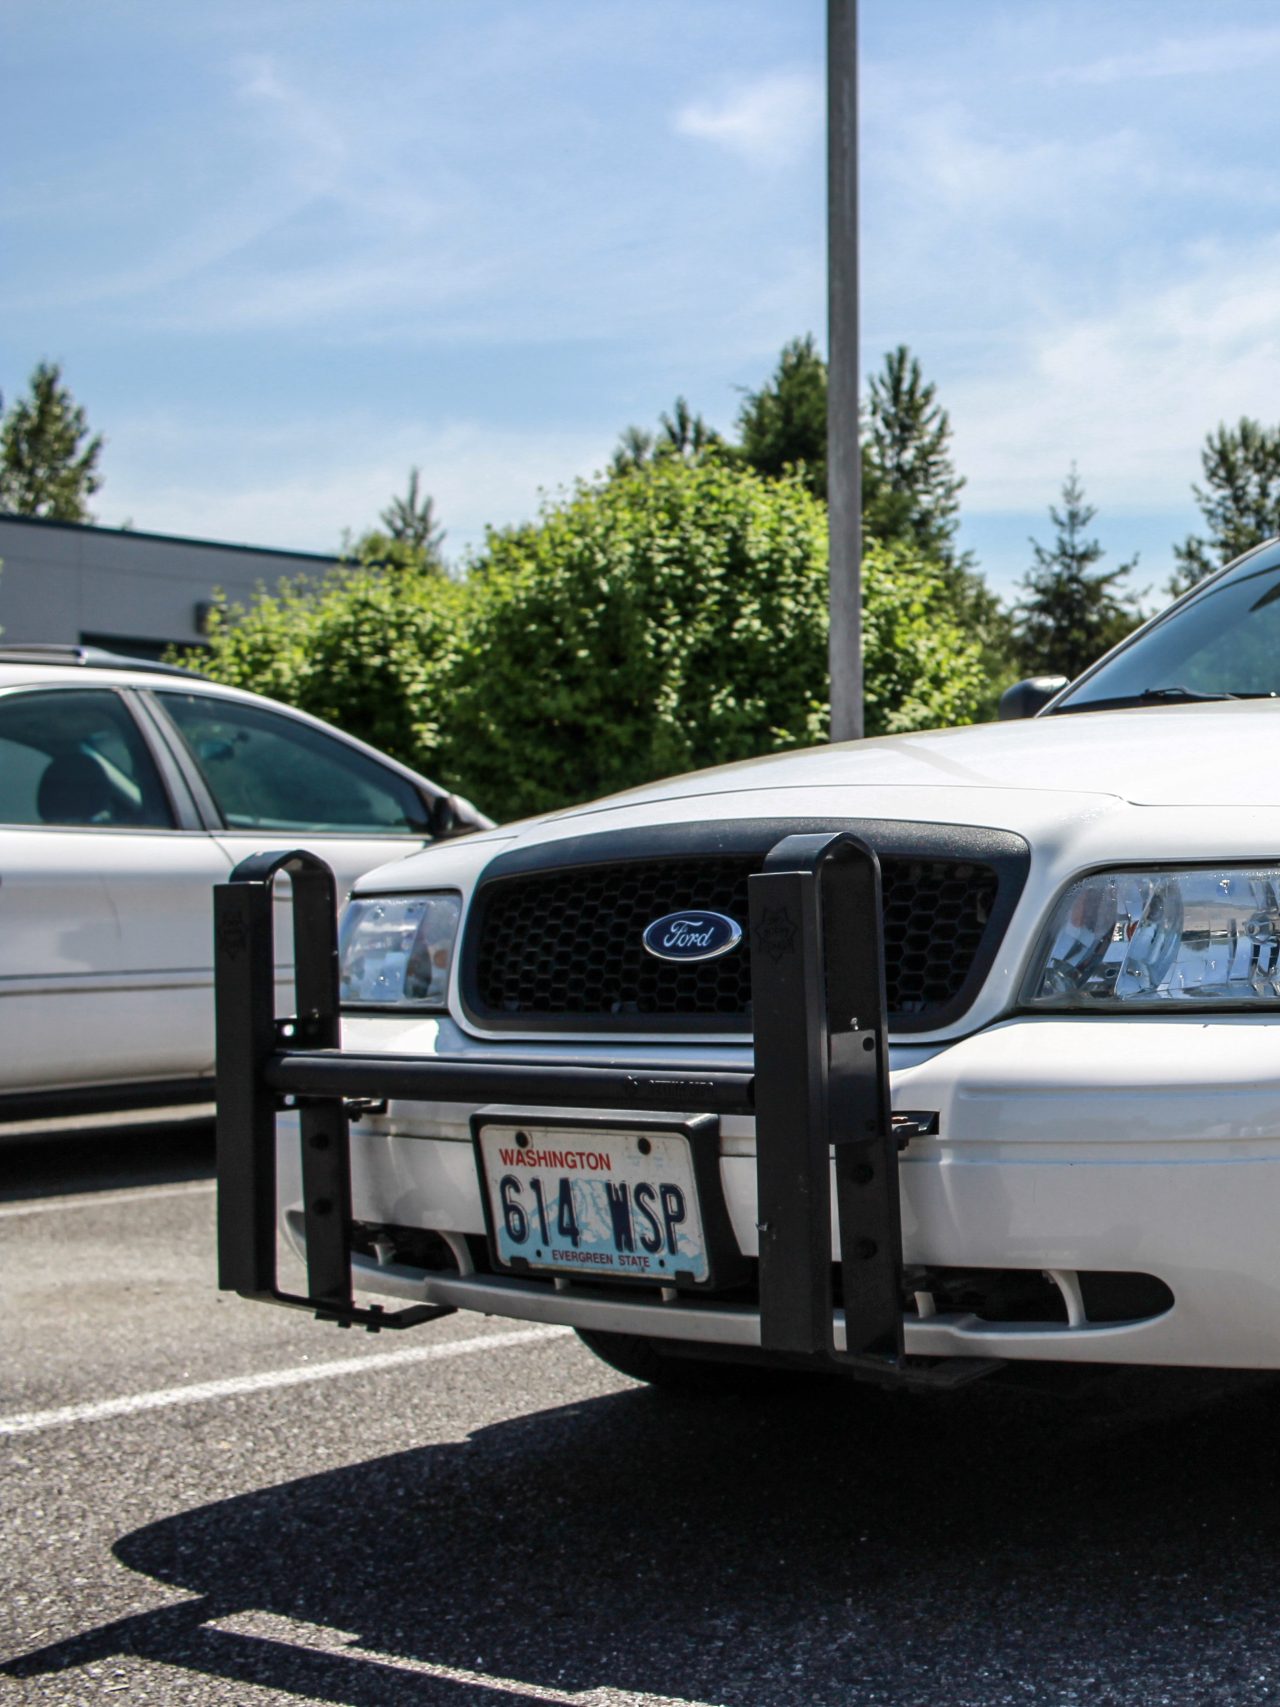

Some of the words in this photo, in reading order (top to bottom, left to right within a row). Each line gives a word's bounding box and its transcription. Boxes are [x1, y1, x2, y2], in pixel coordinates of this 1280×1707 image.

[663, 920, 715, 947] Ford
[499, 1148, 612, 1171] WASHINGTON
[500, 1174, 581, 1248] 614
[606, 1179, 687, 1256] WSP
[552, 1249, 613, 1265] EVERGREEN
[618, 1254, 651, 1268] STATE
